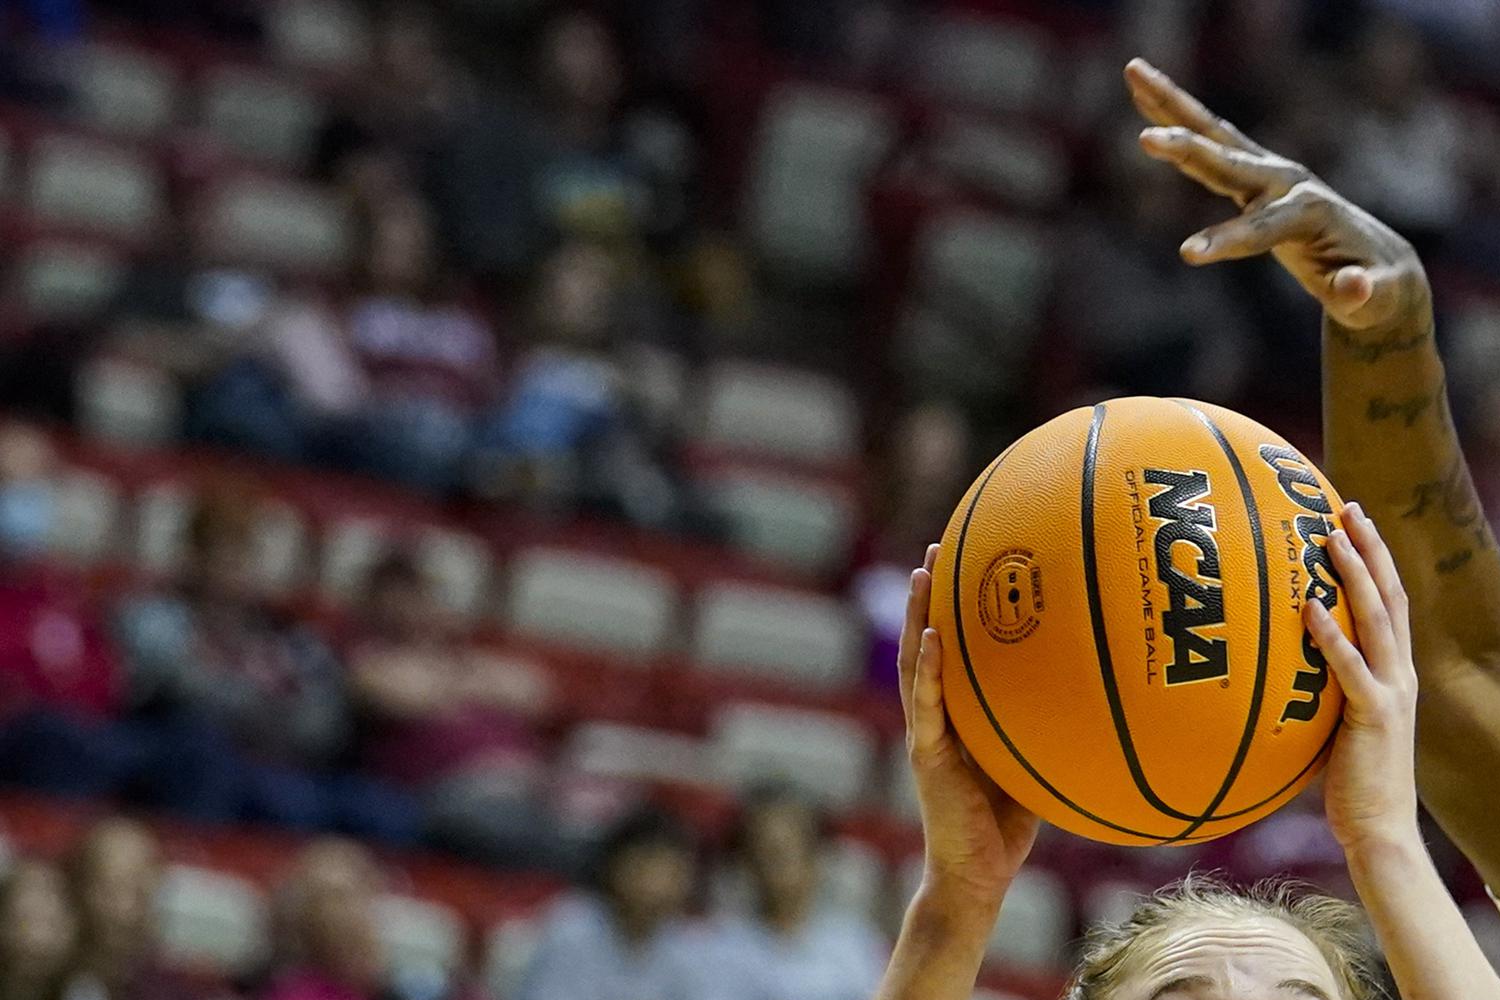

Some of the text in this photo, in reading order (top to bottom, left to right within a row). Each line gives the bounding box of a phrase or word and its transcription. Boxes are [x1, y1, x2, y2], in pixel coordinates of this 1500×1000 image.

[1125, 470, 1157, 685] OFFICIAL GAME BALL
[1143, 468, 1229, 687] NCAA
[1281, 519, 1301, 613] EVO NXT
